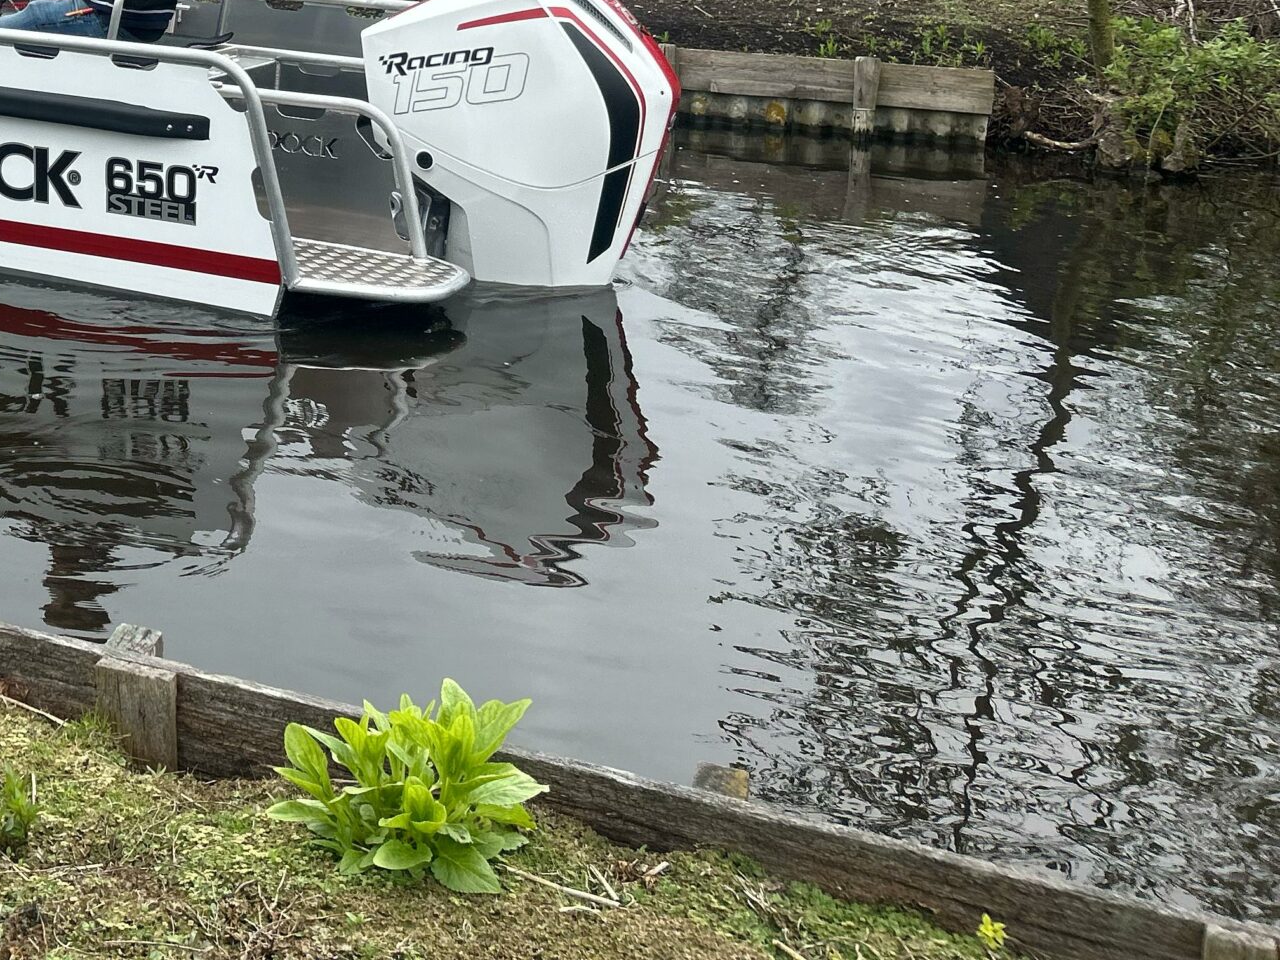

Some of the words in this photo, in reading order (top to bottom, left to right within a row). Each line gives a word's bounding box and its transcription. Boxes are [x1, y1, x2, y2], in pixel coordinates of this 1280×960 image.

[379, 47, 494, 76] Racing
[393, 52, 530, 115] 150
[106, 193, 197, 226] STEEL
